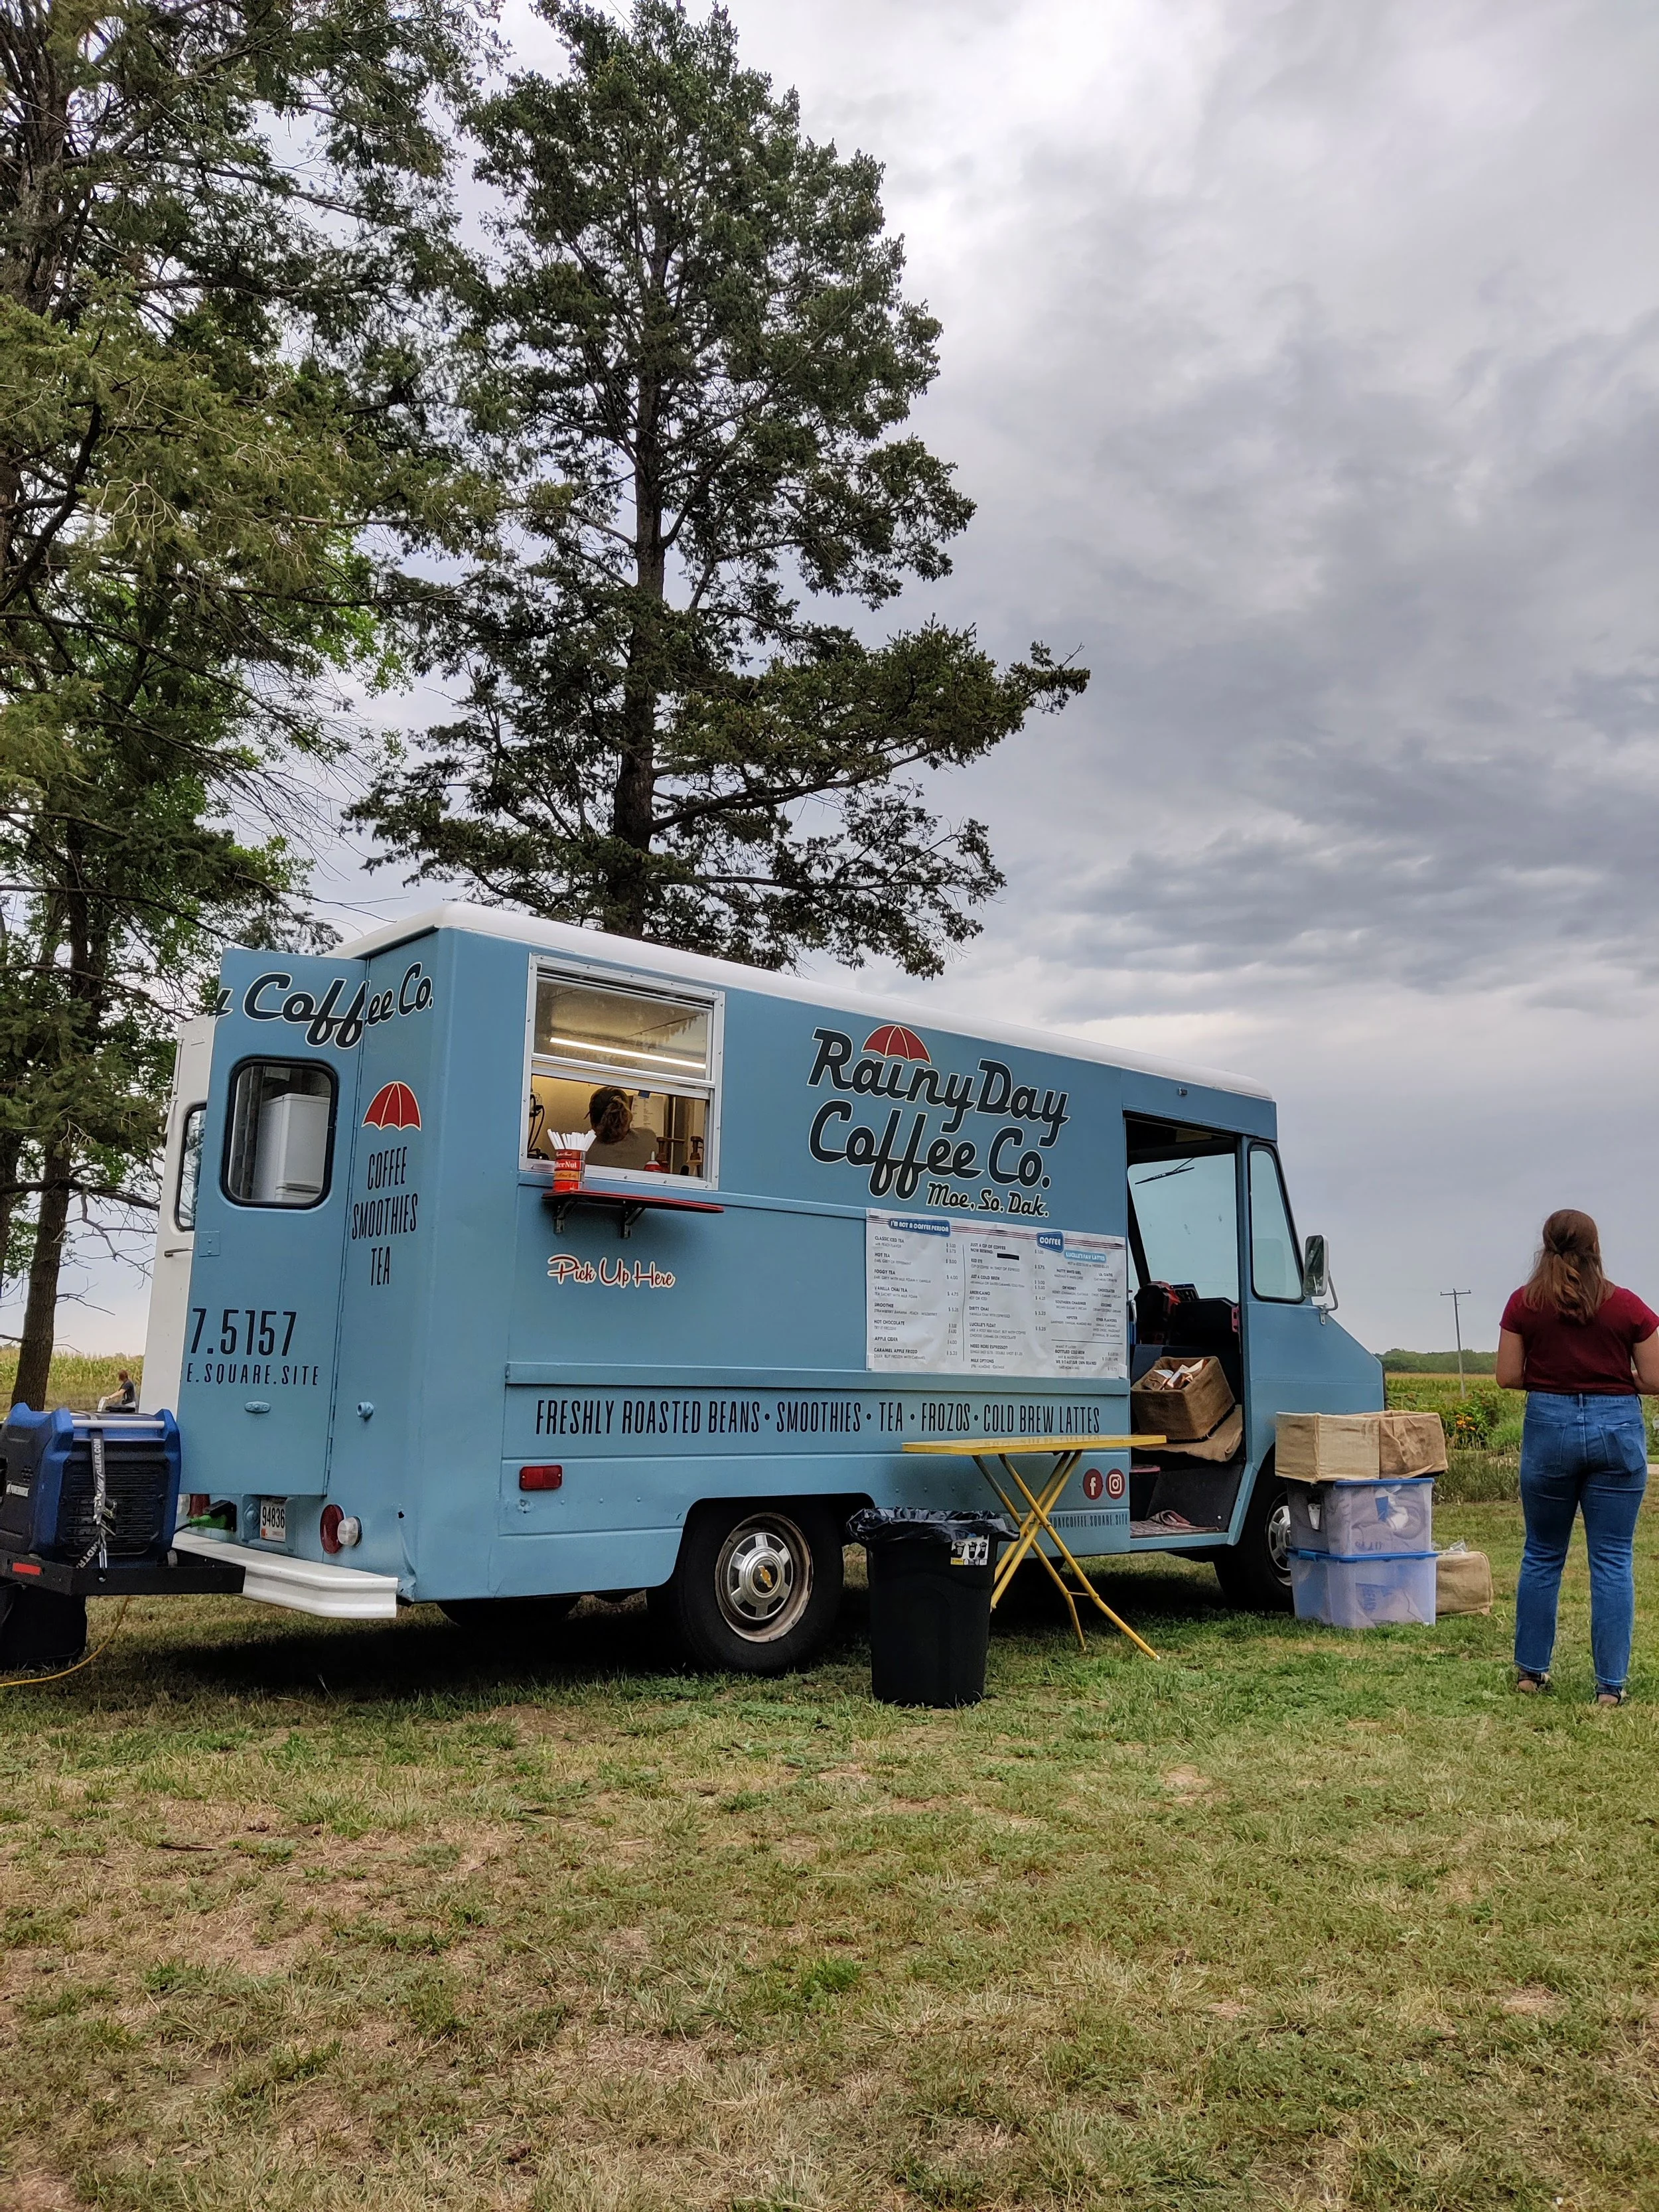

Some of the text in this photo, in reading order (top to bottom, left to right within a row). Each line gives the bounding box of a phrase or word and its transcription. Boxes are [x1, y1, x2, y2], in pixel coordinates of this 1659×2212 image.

[243, 972, 397, 1049] Coffee
[398, 962, 434, 1017] Co.
[807, 1027, 1071, 1148] Rainy Day
[366, 1146, 407, 1191] COFFEE
[809, 1099, 1052, 1200] Coffee Co.
[351, 1194, 419, 1240] SMOOTHIES
[977, 1189, 1005, 1214] So.
[1007, 1191, 1049, 1218] Dak.
[1039, 1236, 1061, 1246] COFFEE
[370, 1246, 390, 1286] TEA
[547, 1253, 676, 1289] Pick Up Here
[190, 1308, 297, 1356] 7.5157
[536, 1400, 1100, 1434] FRESHLY ROASTED BEANS SMOOTHIES TEA FROZOS COLD BREW LATTES
[262, 1506, 285, 1529] 94836
